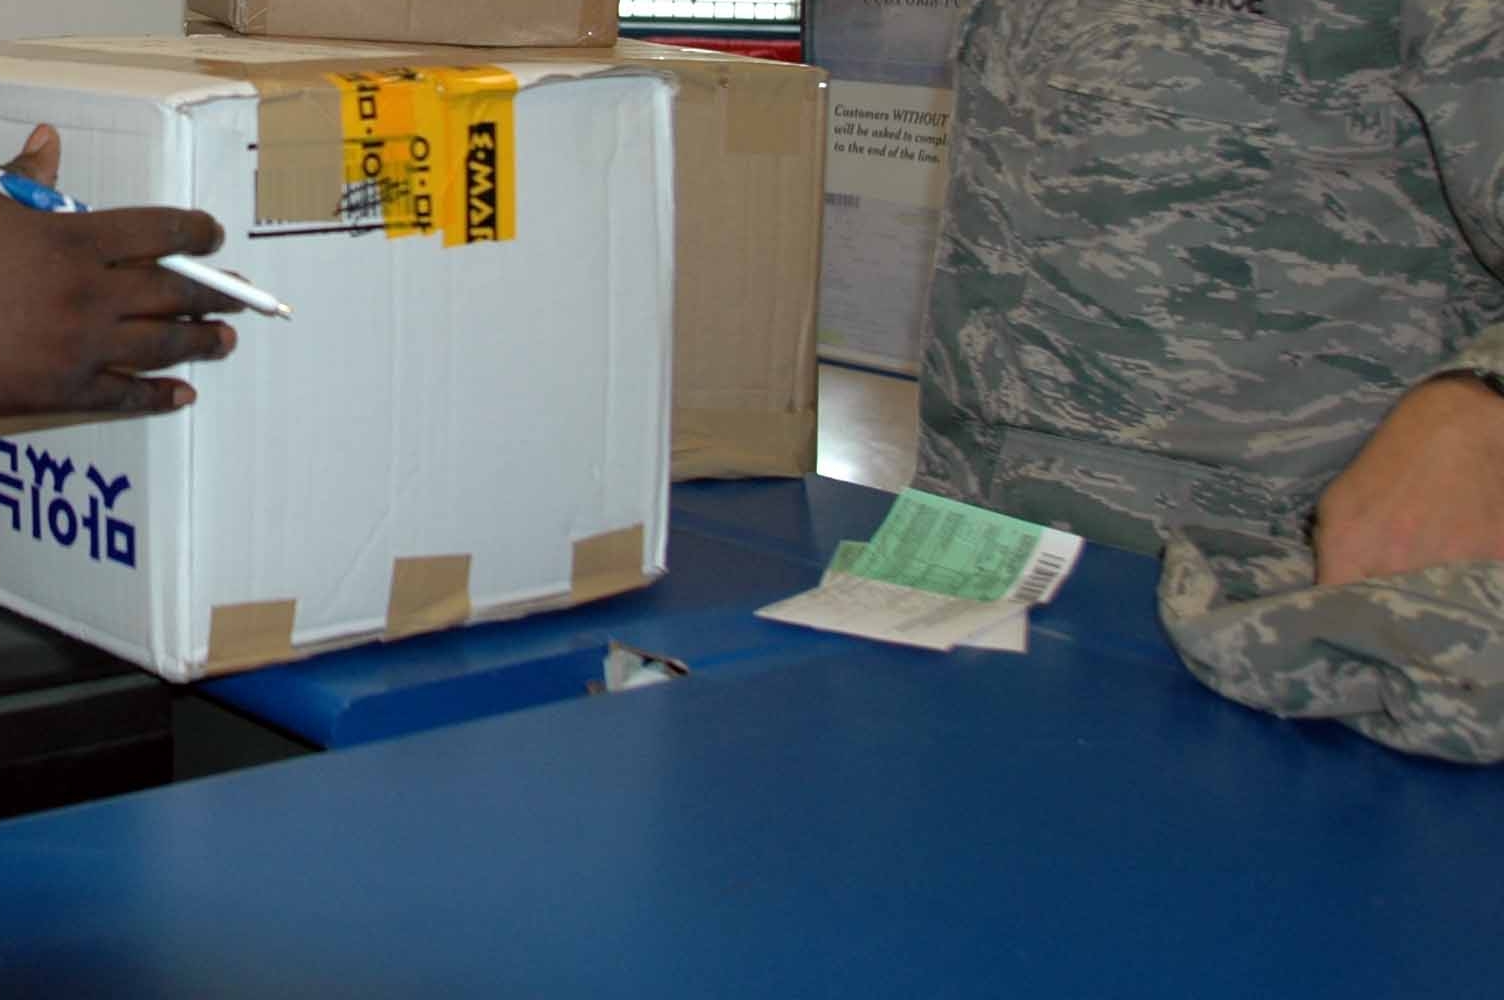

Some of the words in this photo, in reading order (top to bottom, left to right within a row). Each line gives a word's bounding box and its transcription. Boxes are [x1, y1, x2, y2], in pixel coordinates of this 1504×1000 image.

[834, 104, 889, 121] Customers
[892, 108, 951, 127] WITHOUT
[834, 122, 854, 136] will
[856, 124, 869, 137] be
[872, 127, 902, 141] asked
[903, 130, 913, 142] to
[834, 141, 845, 152] to
[848, 141, 865, 154] the
[867, 144, 887, 157] end
[887, 146, 900, 158] of
[900, 147, 915, 160] the
